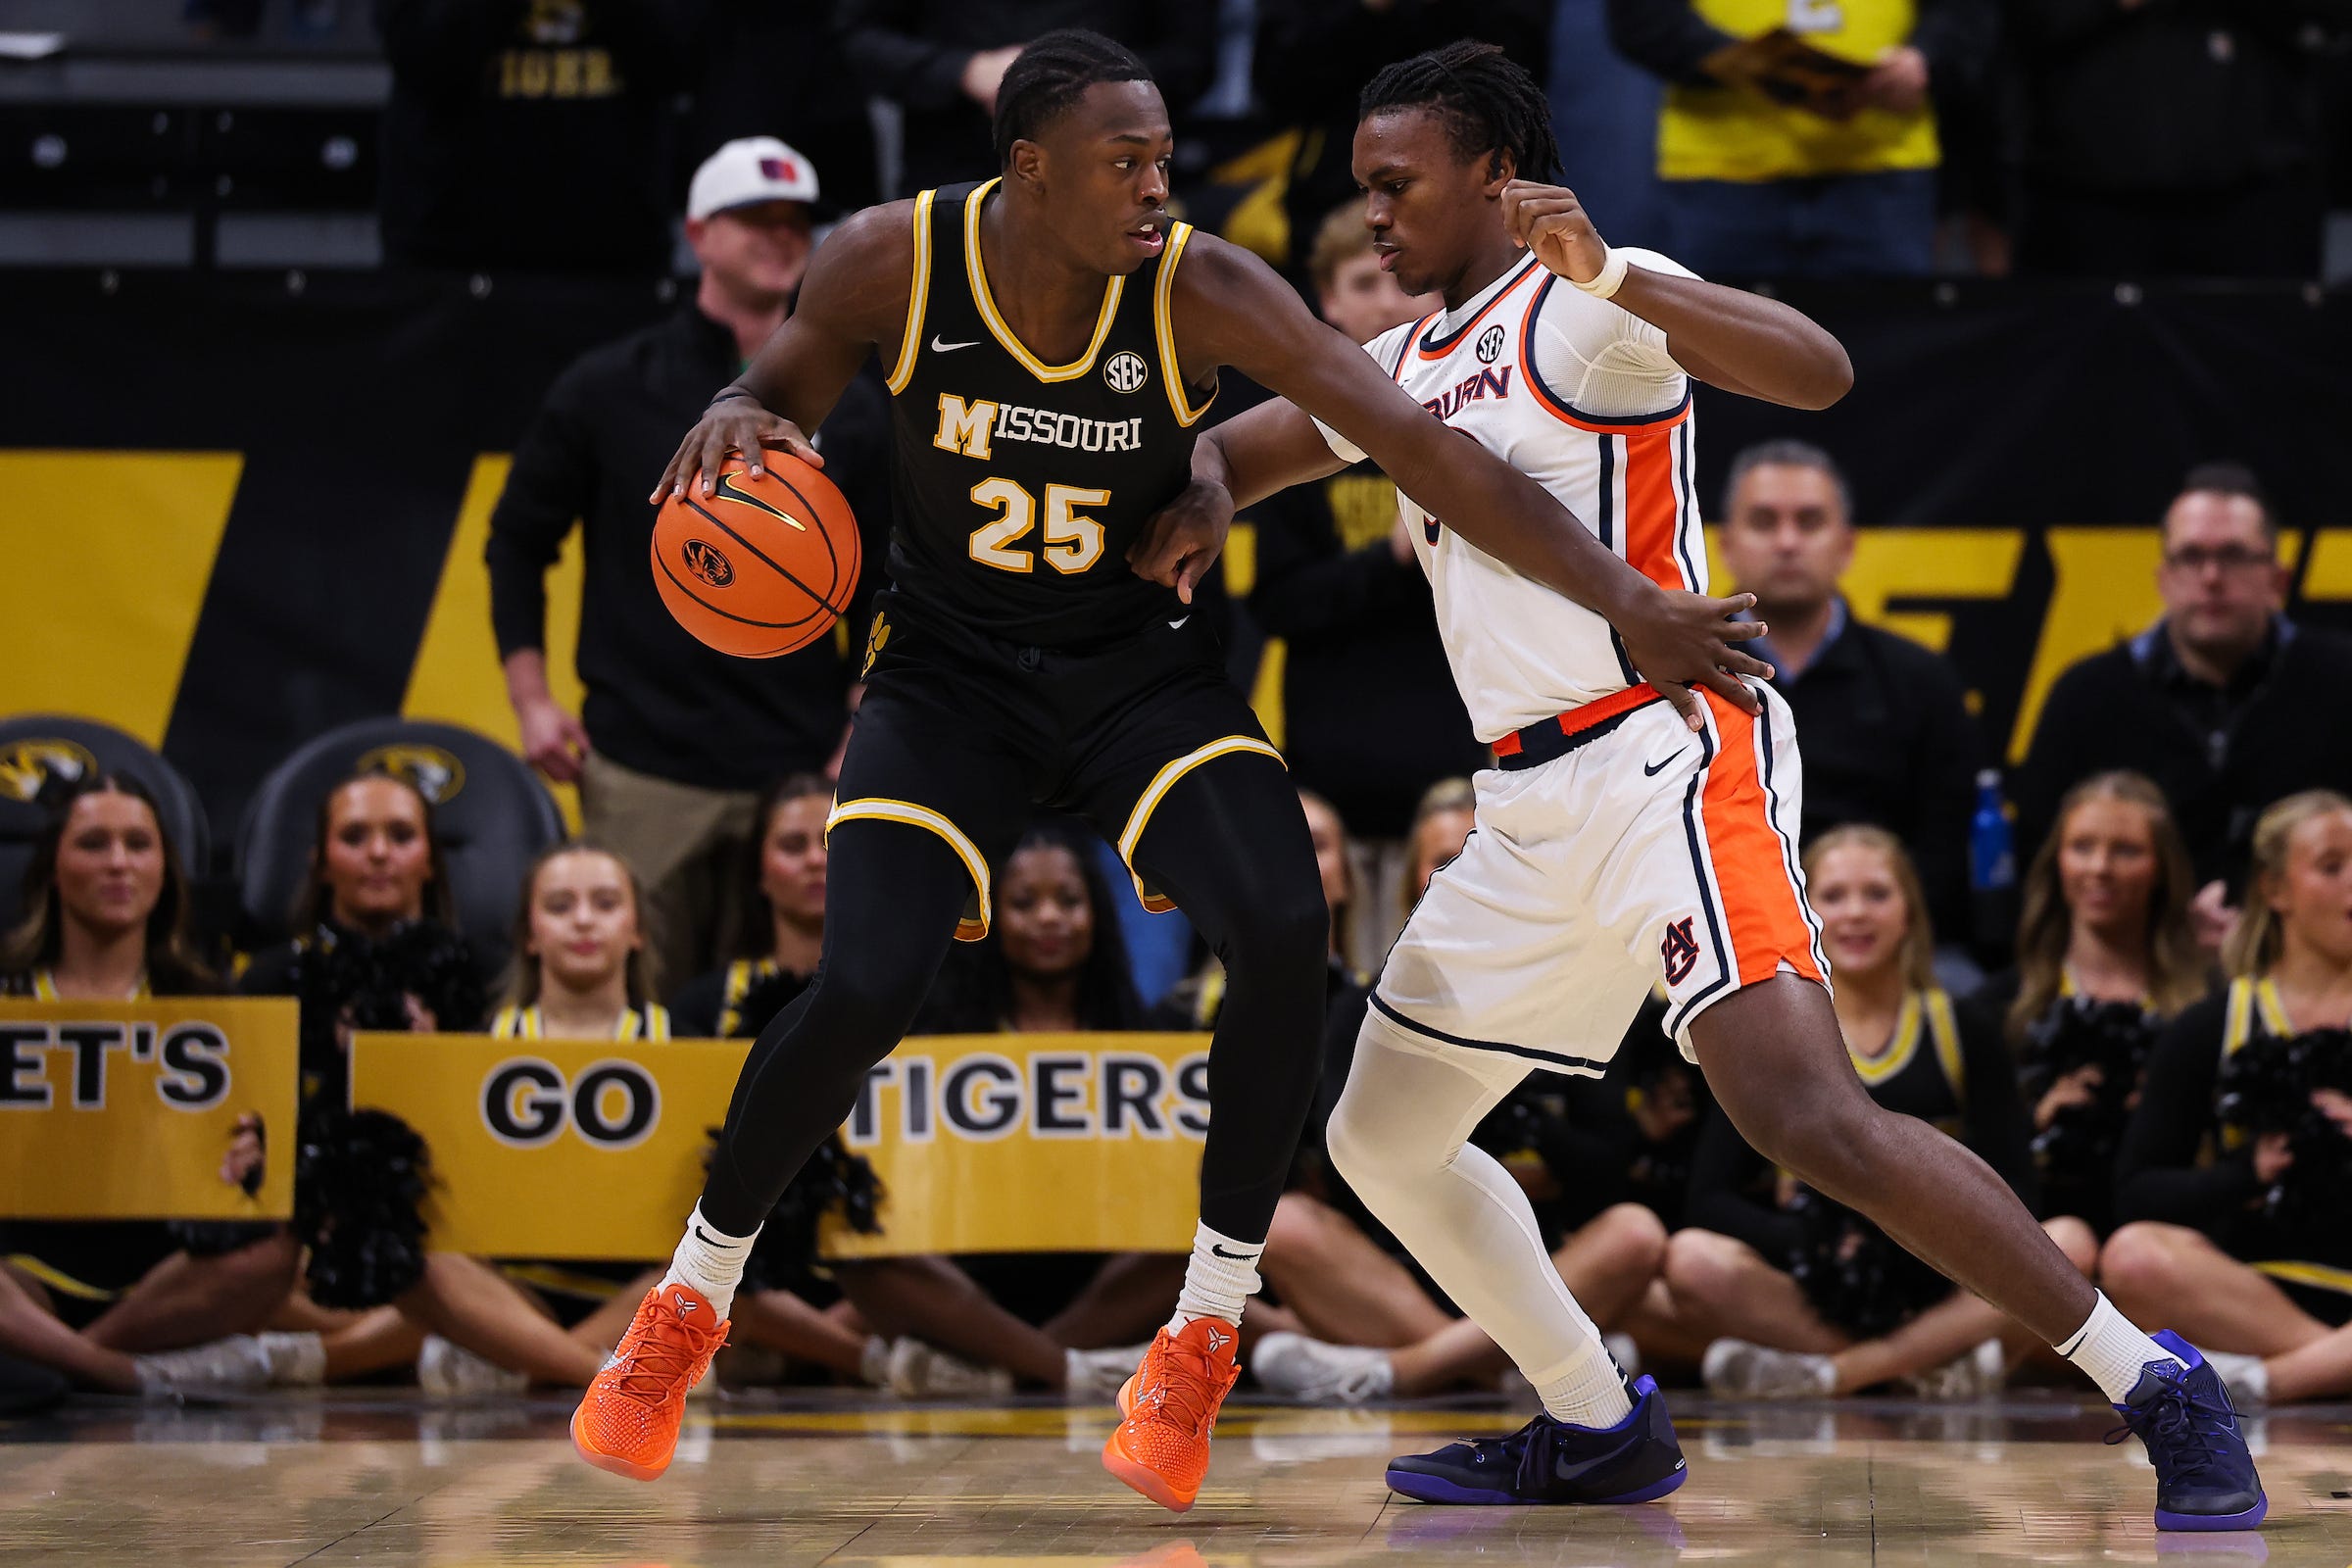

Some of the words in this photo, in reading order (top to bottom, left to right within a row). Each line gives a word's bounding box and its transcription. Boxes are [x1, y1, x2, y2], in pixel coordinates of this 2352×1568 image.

[1106, 353, 1146, 391] SEC
[1477, 325, 1504, 363] SEC
[933, 392, 1143, 461] MISSOURI
[1422, 365, 1512, 422] BURN
[969, 476, 1111, 575] 25
[0, 1023, 229, 1110] ET'S
[481, 1057, 661, 1149] GO
